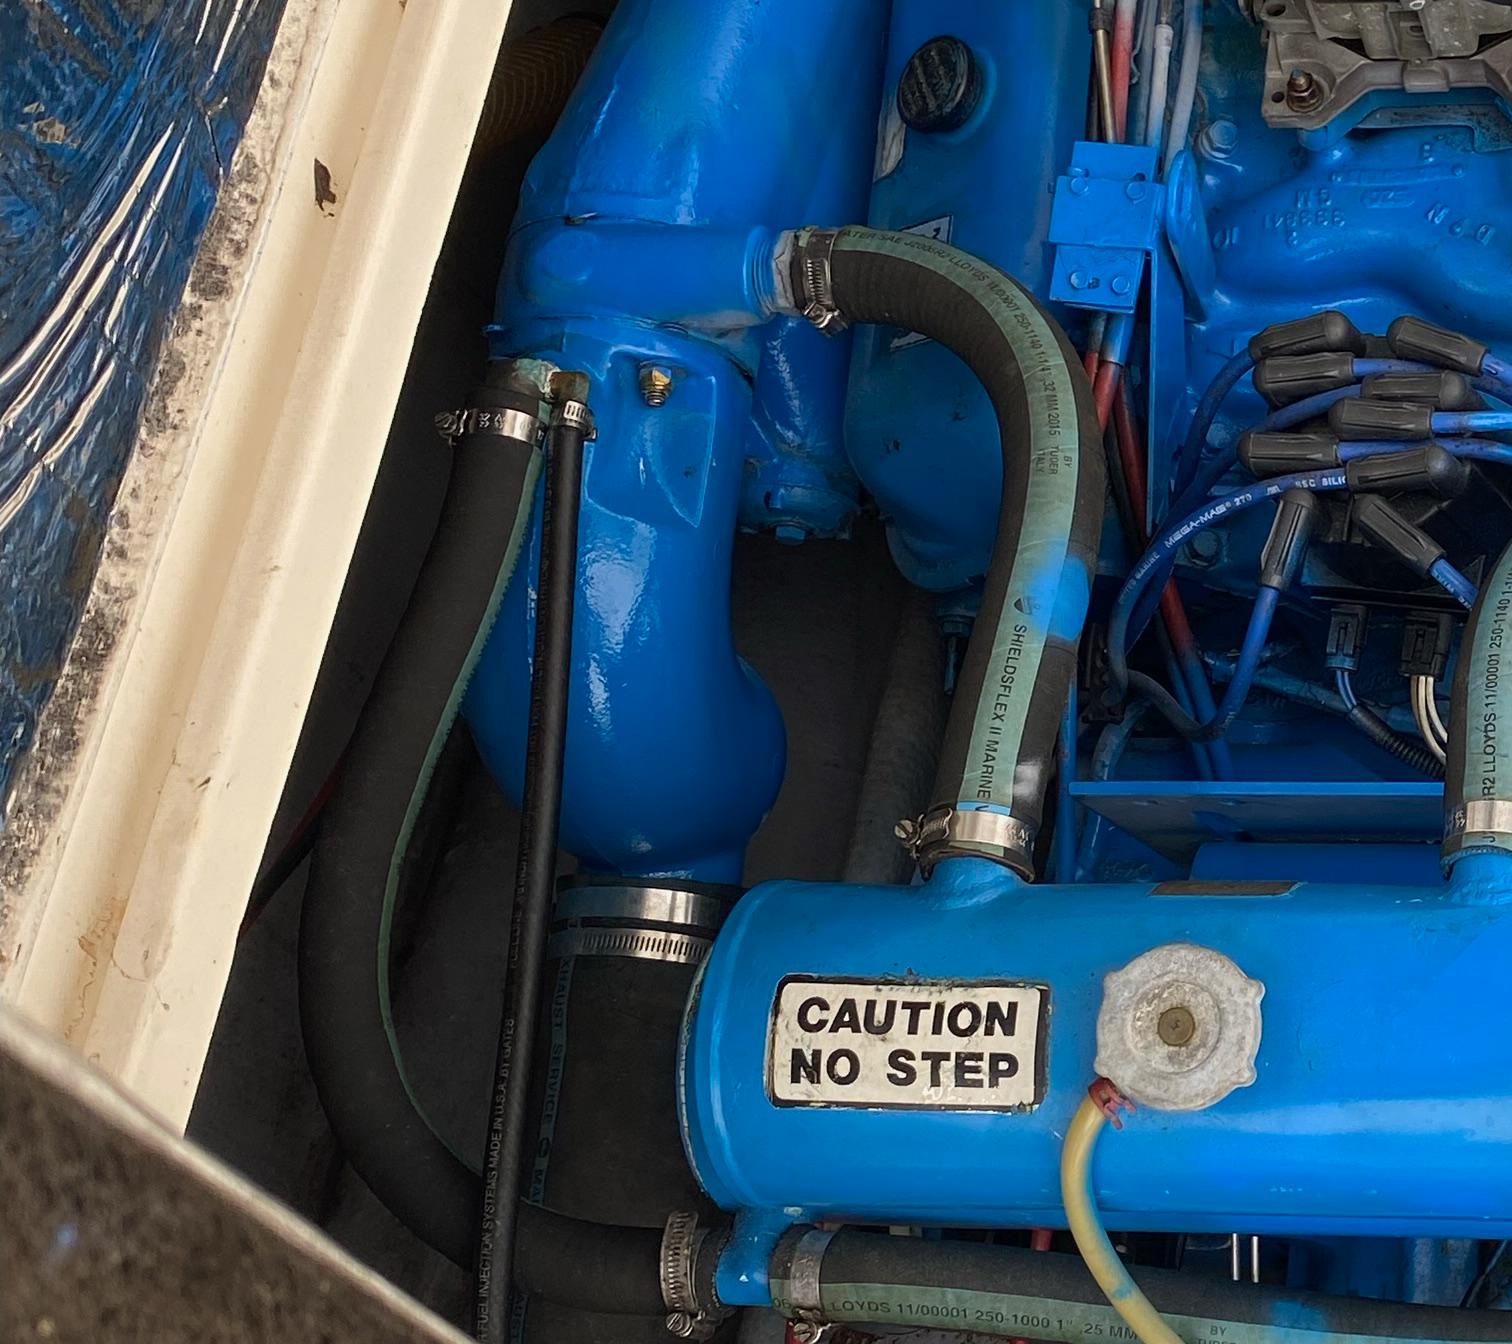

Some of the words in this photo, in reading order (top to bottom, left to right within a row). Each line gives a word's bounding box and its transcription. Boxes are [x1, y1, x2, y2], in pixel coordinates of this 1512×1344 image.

[878, 233, 901, 245] SAE
[948, 256, 990, 283] LLOYDS
[1014, 311, 1045, 350] 250-1140
[1049, 412, 1061, 437] 2015
[1233, 493, 1252, 506] 270
[1488, 596, 1511, 650] 250-1140
[991, 623, 1028, 723] SHIELDSFLEX
[1485, 652, 1501, 708] 11/00001
[976, 738, 1000, 800] MARINE
[1483, 712, 1497, 774] LLOYDS
[797, 996, 1019, 1037] CAUTION
[790, 1048, 860, 1085] NO
[886, 1048, 1019, 1088] STEP
[489, 1131, 503, 1168] MADE
[482, 1169, 498, 1231] SYSTEMS
[478, 1232, 493, 1298] INJECTION
[477, 1304, 489, 1331] FUEL
[896, 1301, 969, 1321] 11/00001
[975, 1309, 1051, 1331] 250-1000
[1109, 1326, 1138, 1341] MM
[1209, 1324, 1228, 1337] BY
